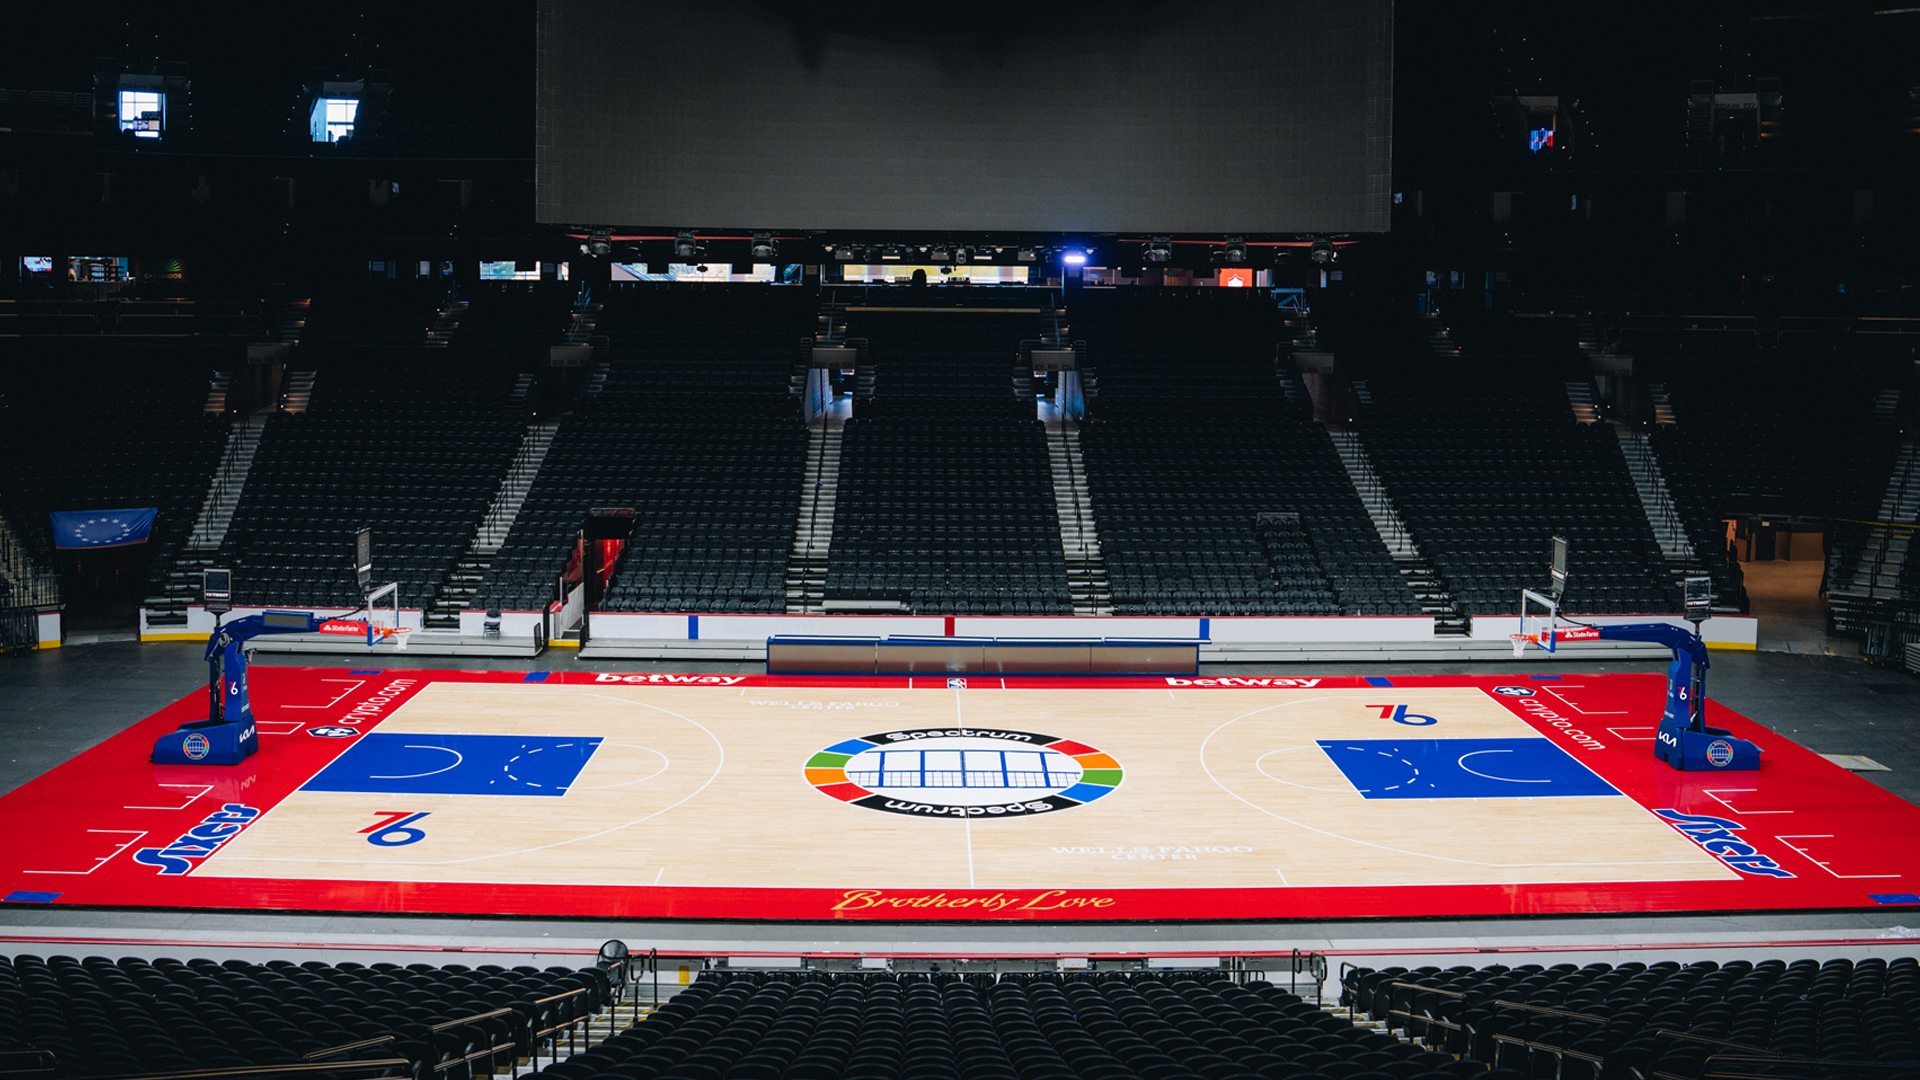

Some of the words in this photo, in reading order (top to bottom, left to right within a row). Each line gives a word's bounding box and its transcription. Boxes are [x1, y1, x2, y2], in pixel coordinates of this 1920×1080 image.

[228, 681, 239, 695] 76
[595, 673, 747, 685] betway
[1165, 677, 1322, 688] betway
[338, 679, 418, 725] crypto.com
[1677, 686, 1688, 701] 76
[1364, 704, 1438, 727] 76
[1518, 698, 1606, 750] crypto.com
[239, 724, 255, 743] KIA
[885, 728, 1033, 742] Spectrum
[1658, 730, 1677, 748] KIA
[884, 799, 1054, 817] Spectrum
[356, 811, 433, 847] 76
[1048, 846, 1150, 854] WELLS
[1157, 845, 1254, 854] FARGO
[830, 889, 1020, 912] Brotherly
[1016, 889, 1117, 911] Love
